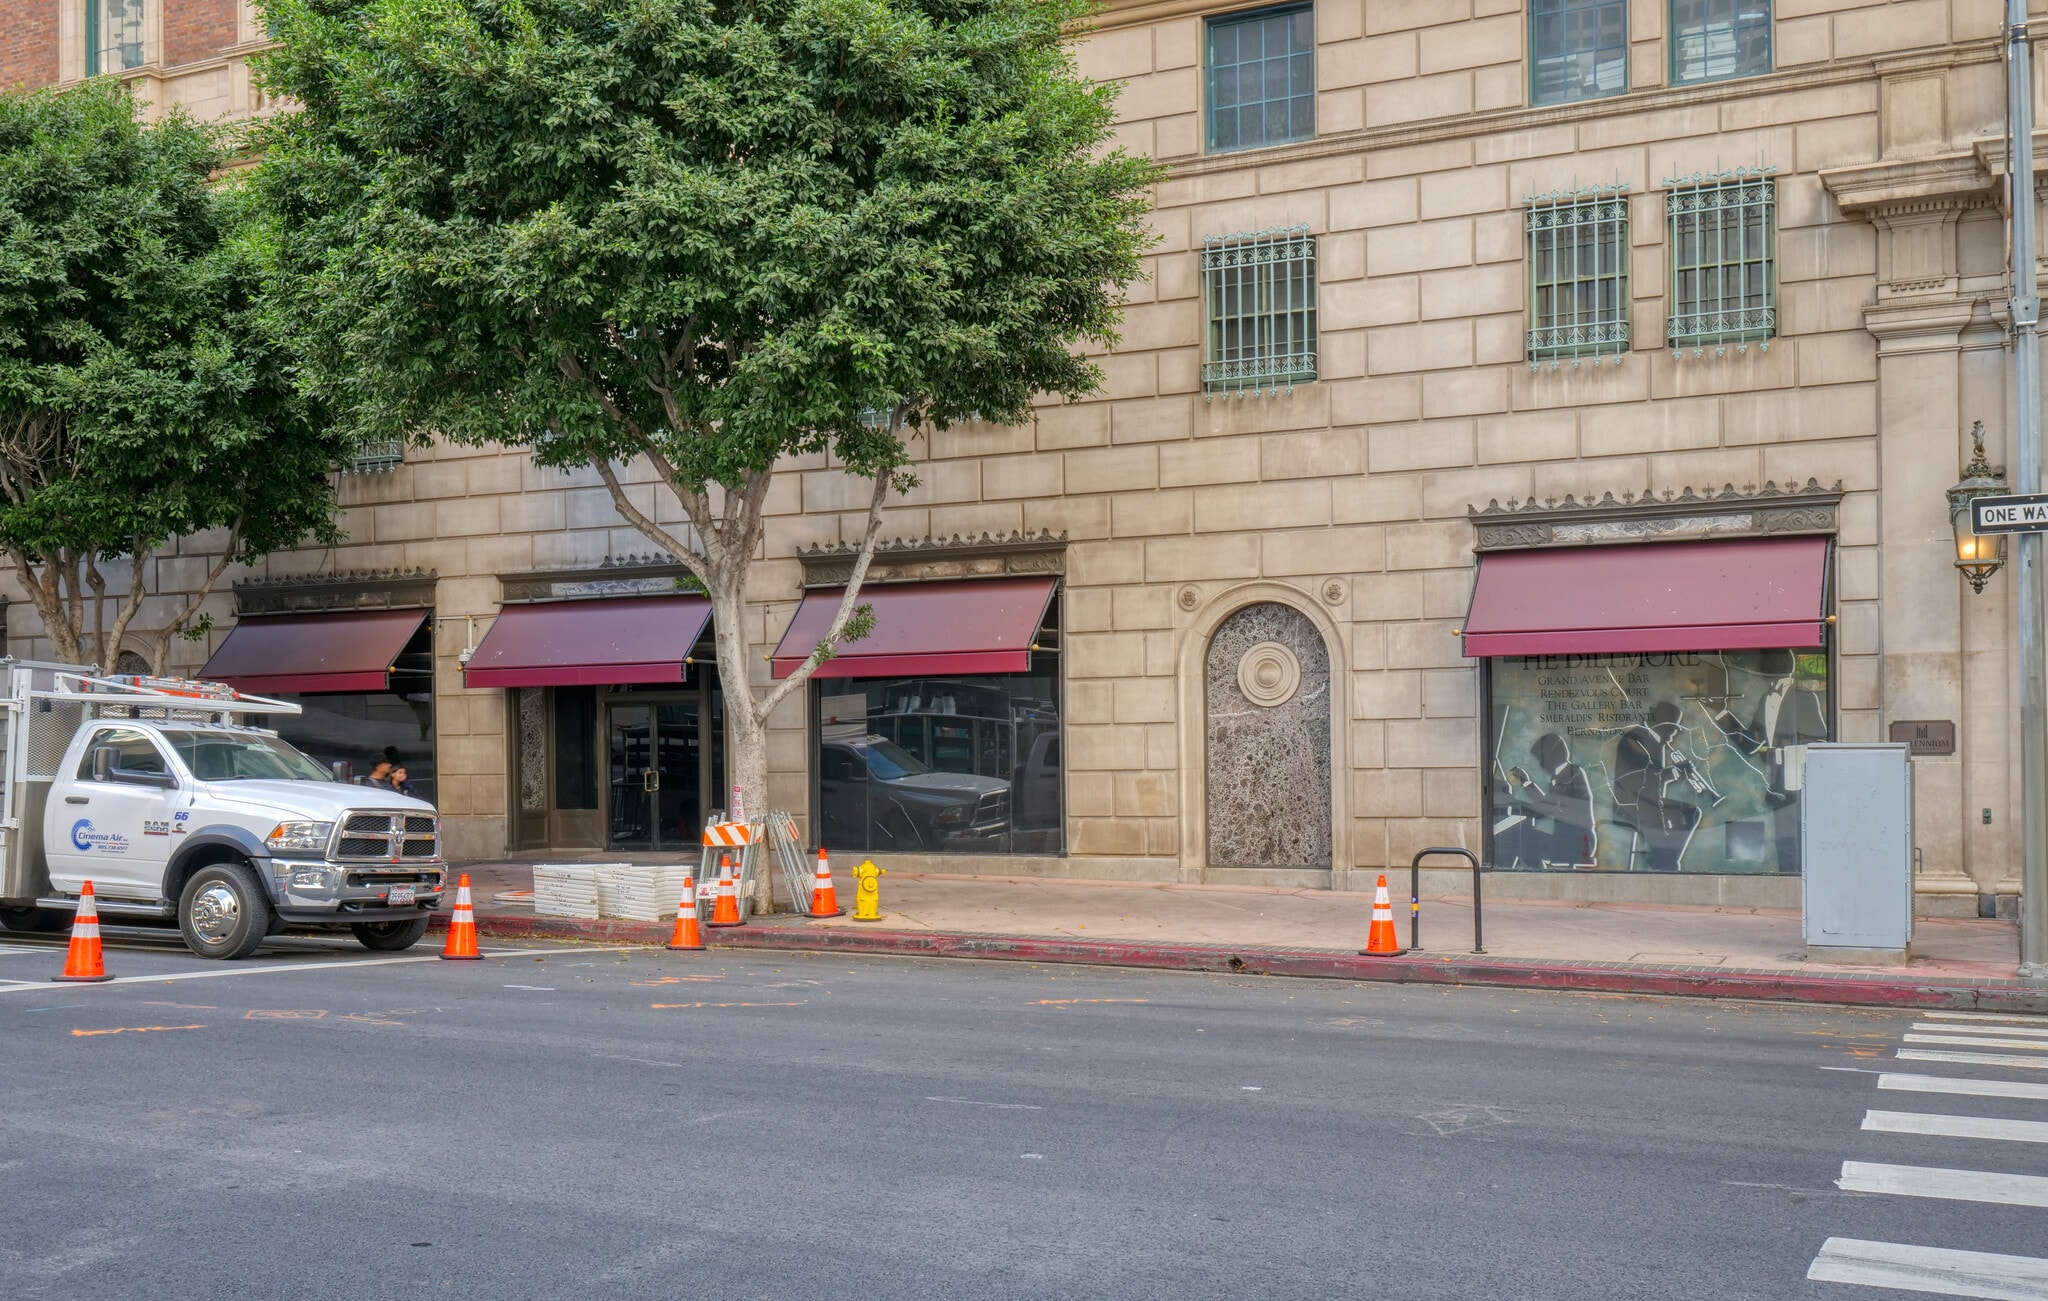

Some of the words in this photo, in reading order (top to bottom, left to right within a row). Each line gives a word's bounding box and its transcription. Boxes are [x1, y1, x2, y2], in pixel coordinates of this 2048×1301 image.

[1985, 508, 2017, 522] ONE
[2023, 506, 2048, 520] WA
[1538, 676, 1577, 686] GRAND
[1581, 675, 1625, 685] AVENUE
[1628, 673, 1650, 683] BAR
[1540, 688, 1610, 698] RENDEZVOUS
[1611, 687, 1648, 697] COURT
[1545, 701, 1570, 710] THE
[1571, 701, 1616, 710] GALLERY
[1620, 700, 1642, 709] BAR
[1598, 712, 1657, 722] RISTORANTE
[1909, 740, 1949, 748] LENNIUM
[175, 811, 189, 821] 66
[144, 820, 169, 828] RAM
[78, 832, 109, 841] Cinema
[110, 834, 123, 842] Air
